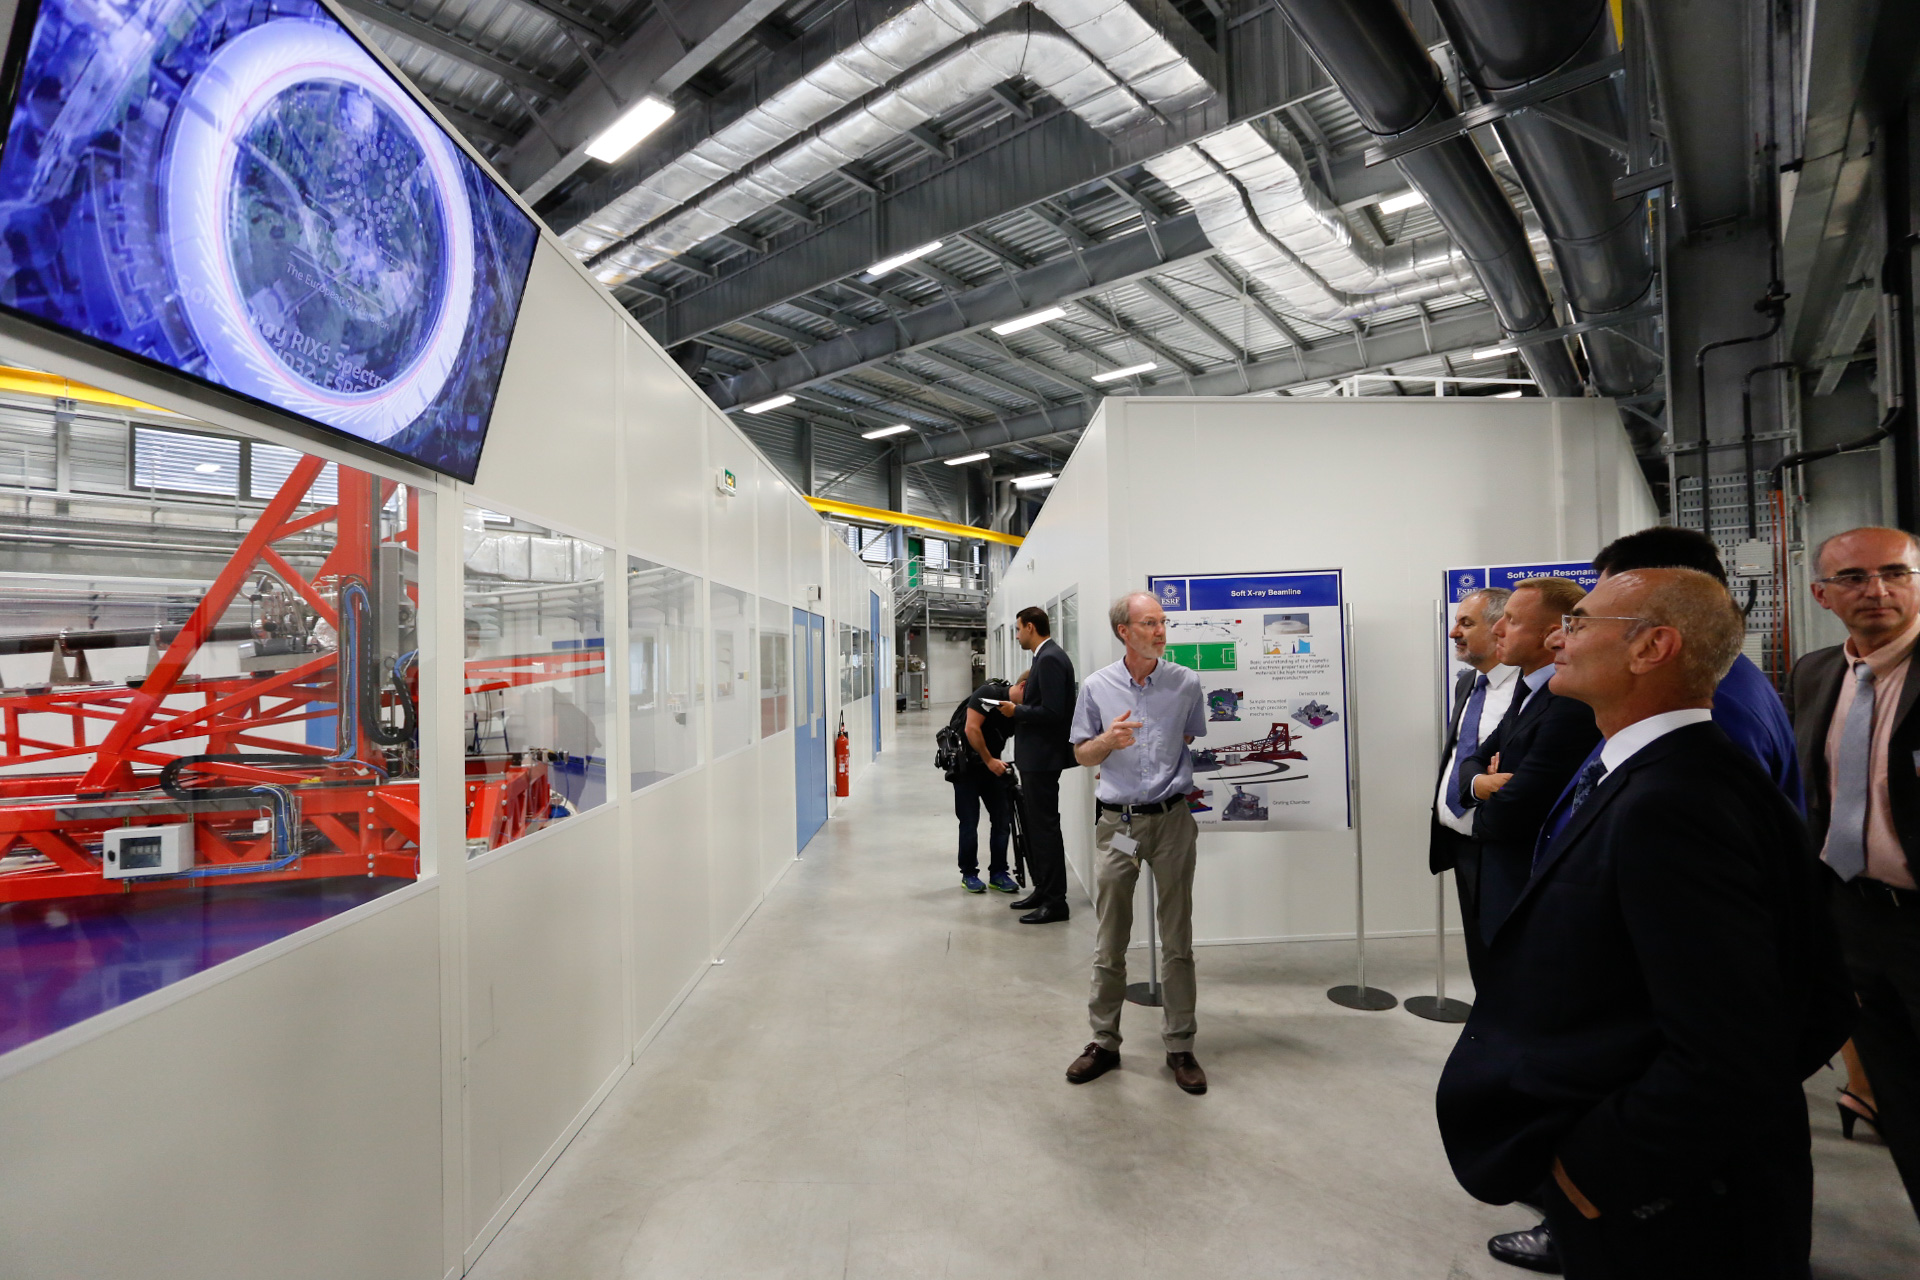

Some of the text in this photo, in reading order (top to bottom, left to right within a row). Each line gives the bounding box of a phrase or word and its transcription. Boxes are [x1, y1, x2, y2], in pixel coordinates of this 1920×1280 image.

[287, 262, 304, 281] The
[304, 274, 345, 306] European
[291, 329, 331, 364] RIXS
[1507, 571, 1525, 579] Soft
[1527, 570, 1551, 578] X-ray
[1247, 590, 1266, 598] X-ray
[1268, 588, 1302, 596] Beamline
[1161, 597, 1180, 605] ESRF
